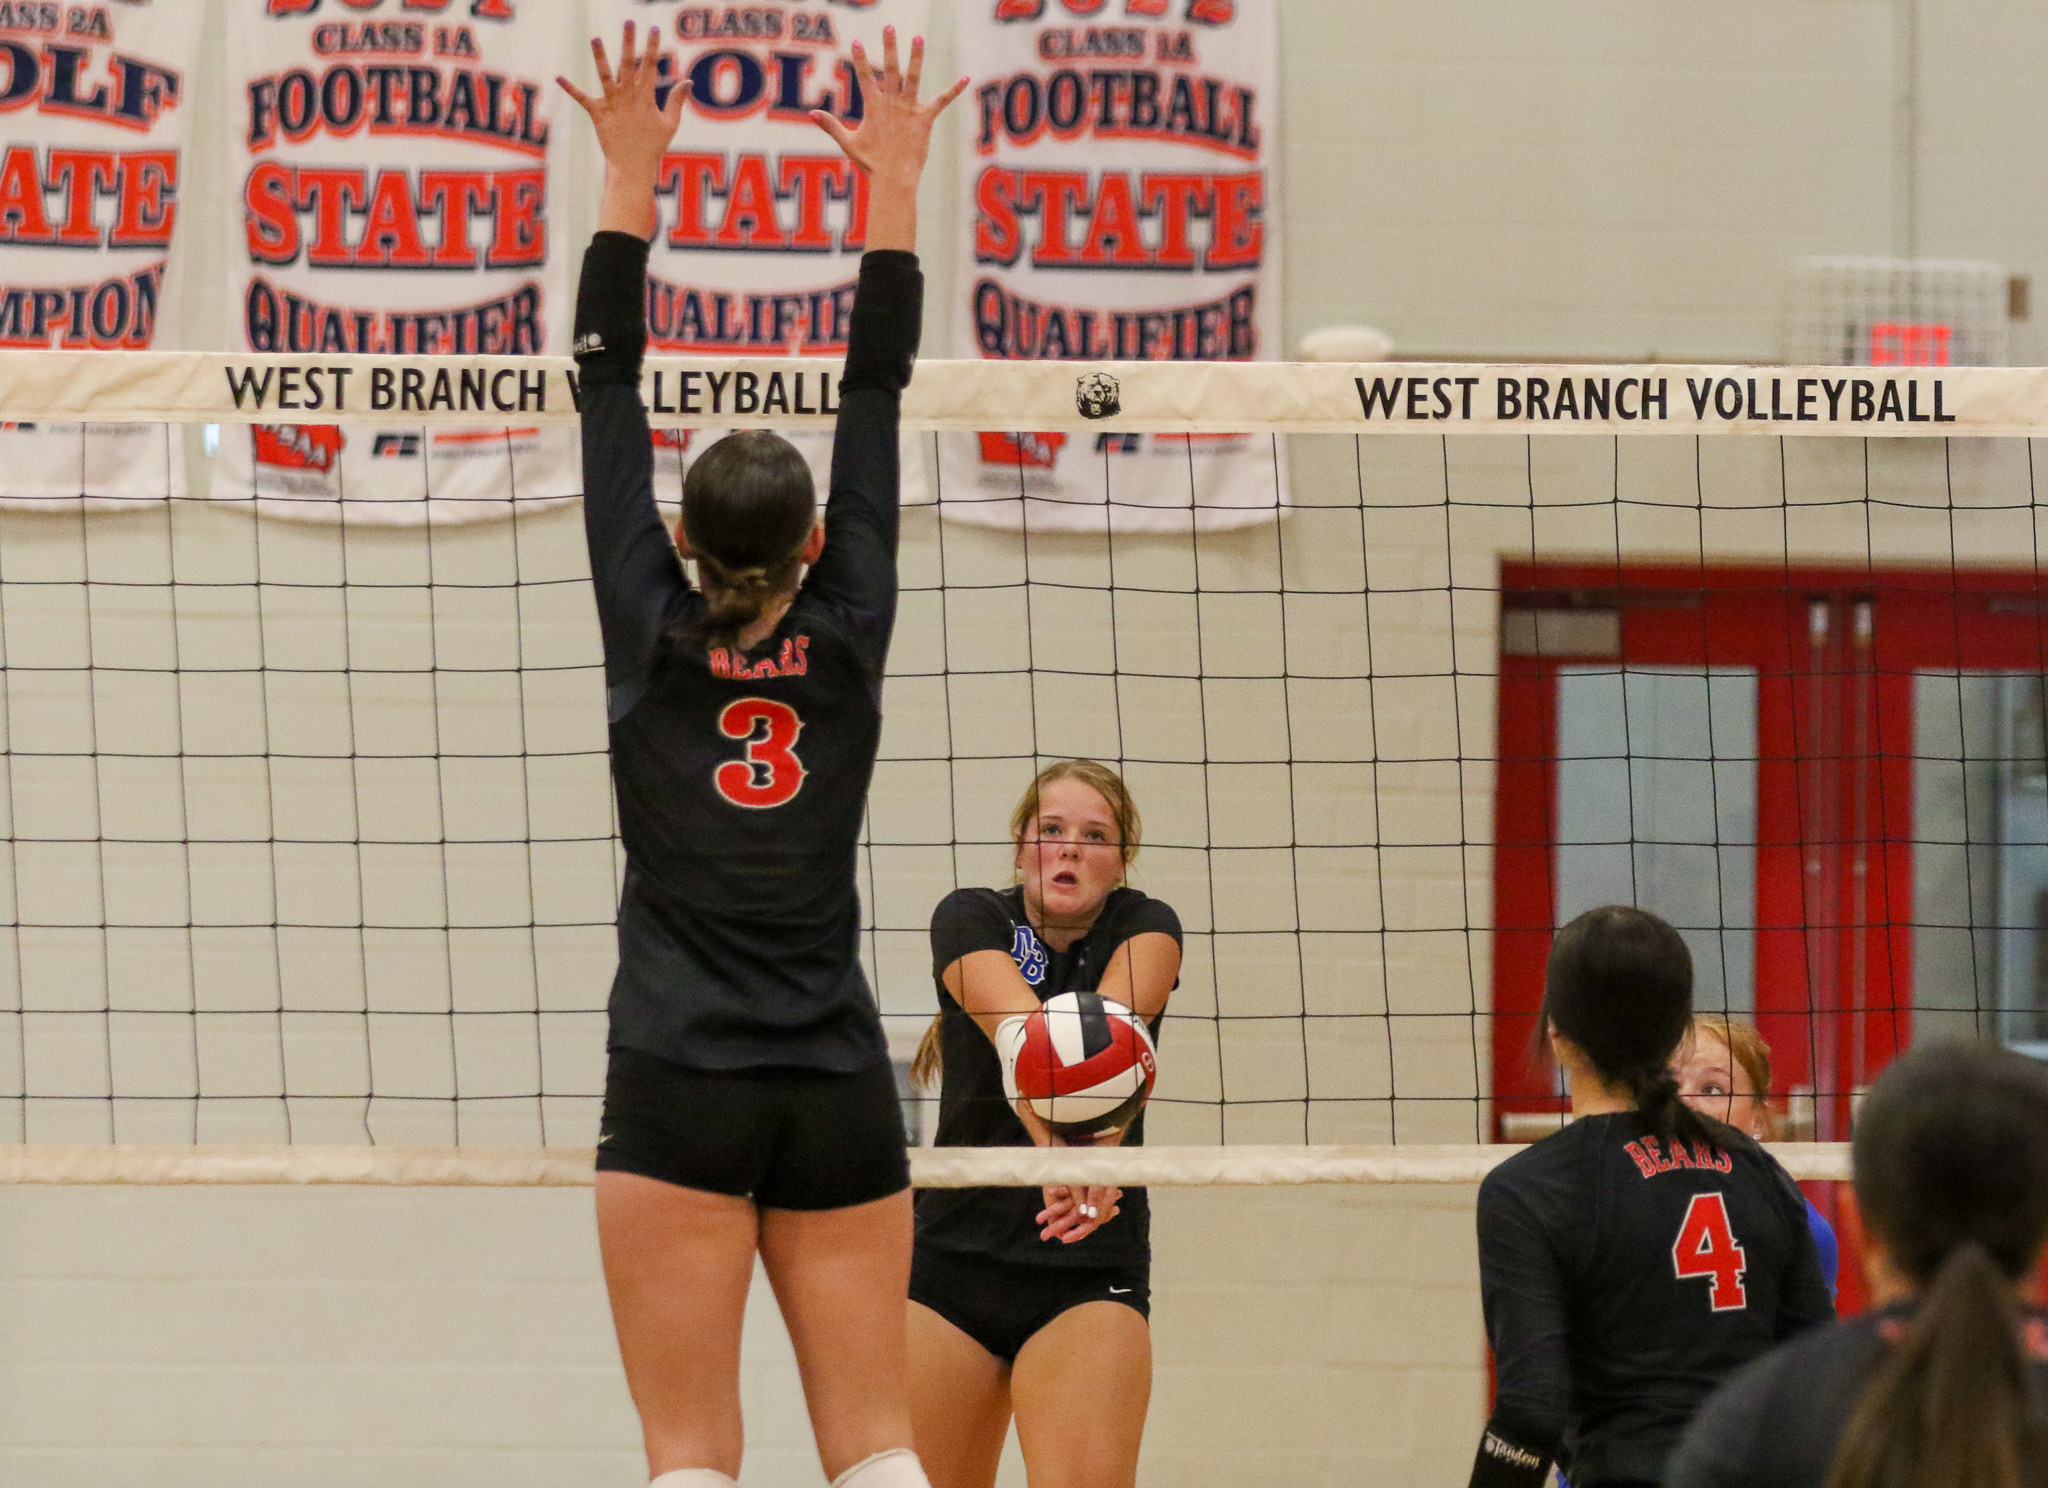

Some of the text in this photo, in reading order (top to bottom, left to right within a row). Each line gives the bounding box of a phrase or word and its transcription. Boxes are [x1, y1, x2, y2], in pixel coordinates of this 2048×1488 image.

[312, 22, 481, 61] CLASS 1A
[675, 8, 786, 42] CLASS
[1037, 27, 1146, 62] CLASS
[248, 63, 551, 158] FOOTBALL
[636, 48, 903, 130] OL
[976, 68, 1260, 161] FOOTBALL
[246, 161, 548, 269] STATE
[652, 151, 870, 252] TAT
[975, 165, 1264, 270] STATE
[246, 274, 546, 353] QUALIFIER
[646, 275, 859, 352] UALIFIE
[973, 280, 1258, 361] QUALIFIER
[225, 366, 353, 409] WEST
[371, 368, 547, 412] BRANCH
[1354, 376, 1956, 423] WEST BRANCH VOLLEYBALL
[714, 697, 806, 809] 3
[1672, 1191, 1748, 1312] 4
